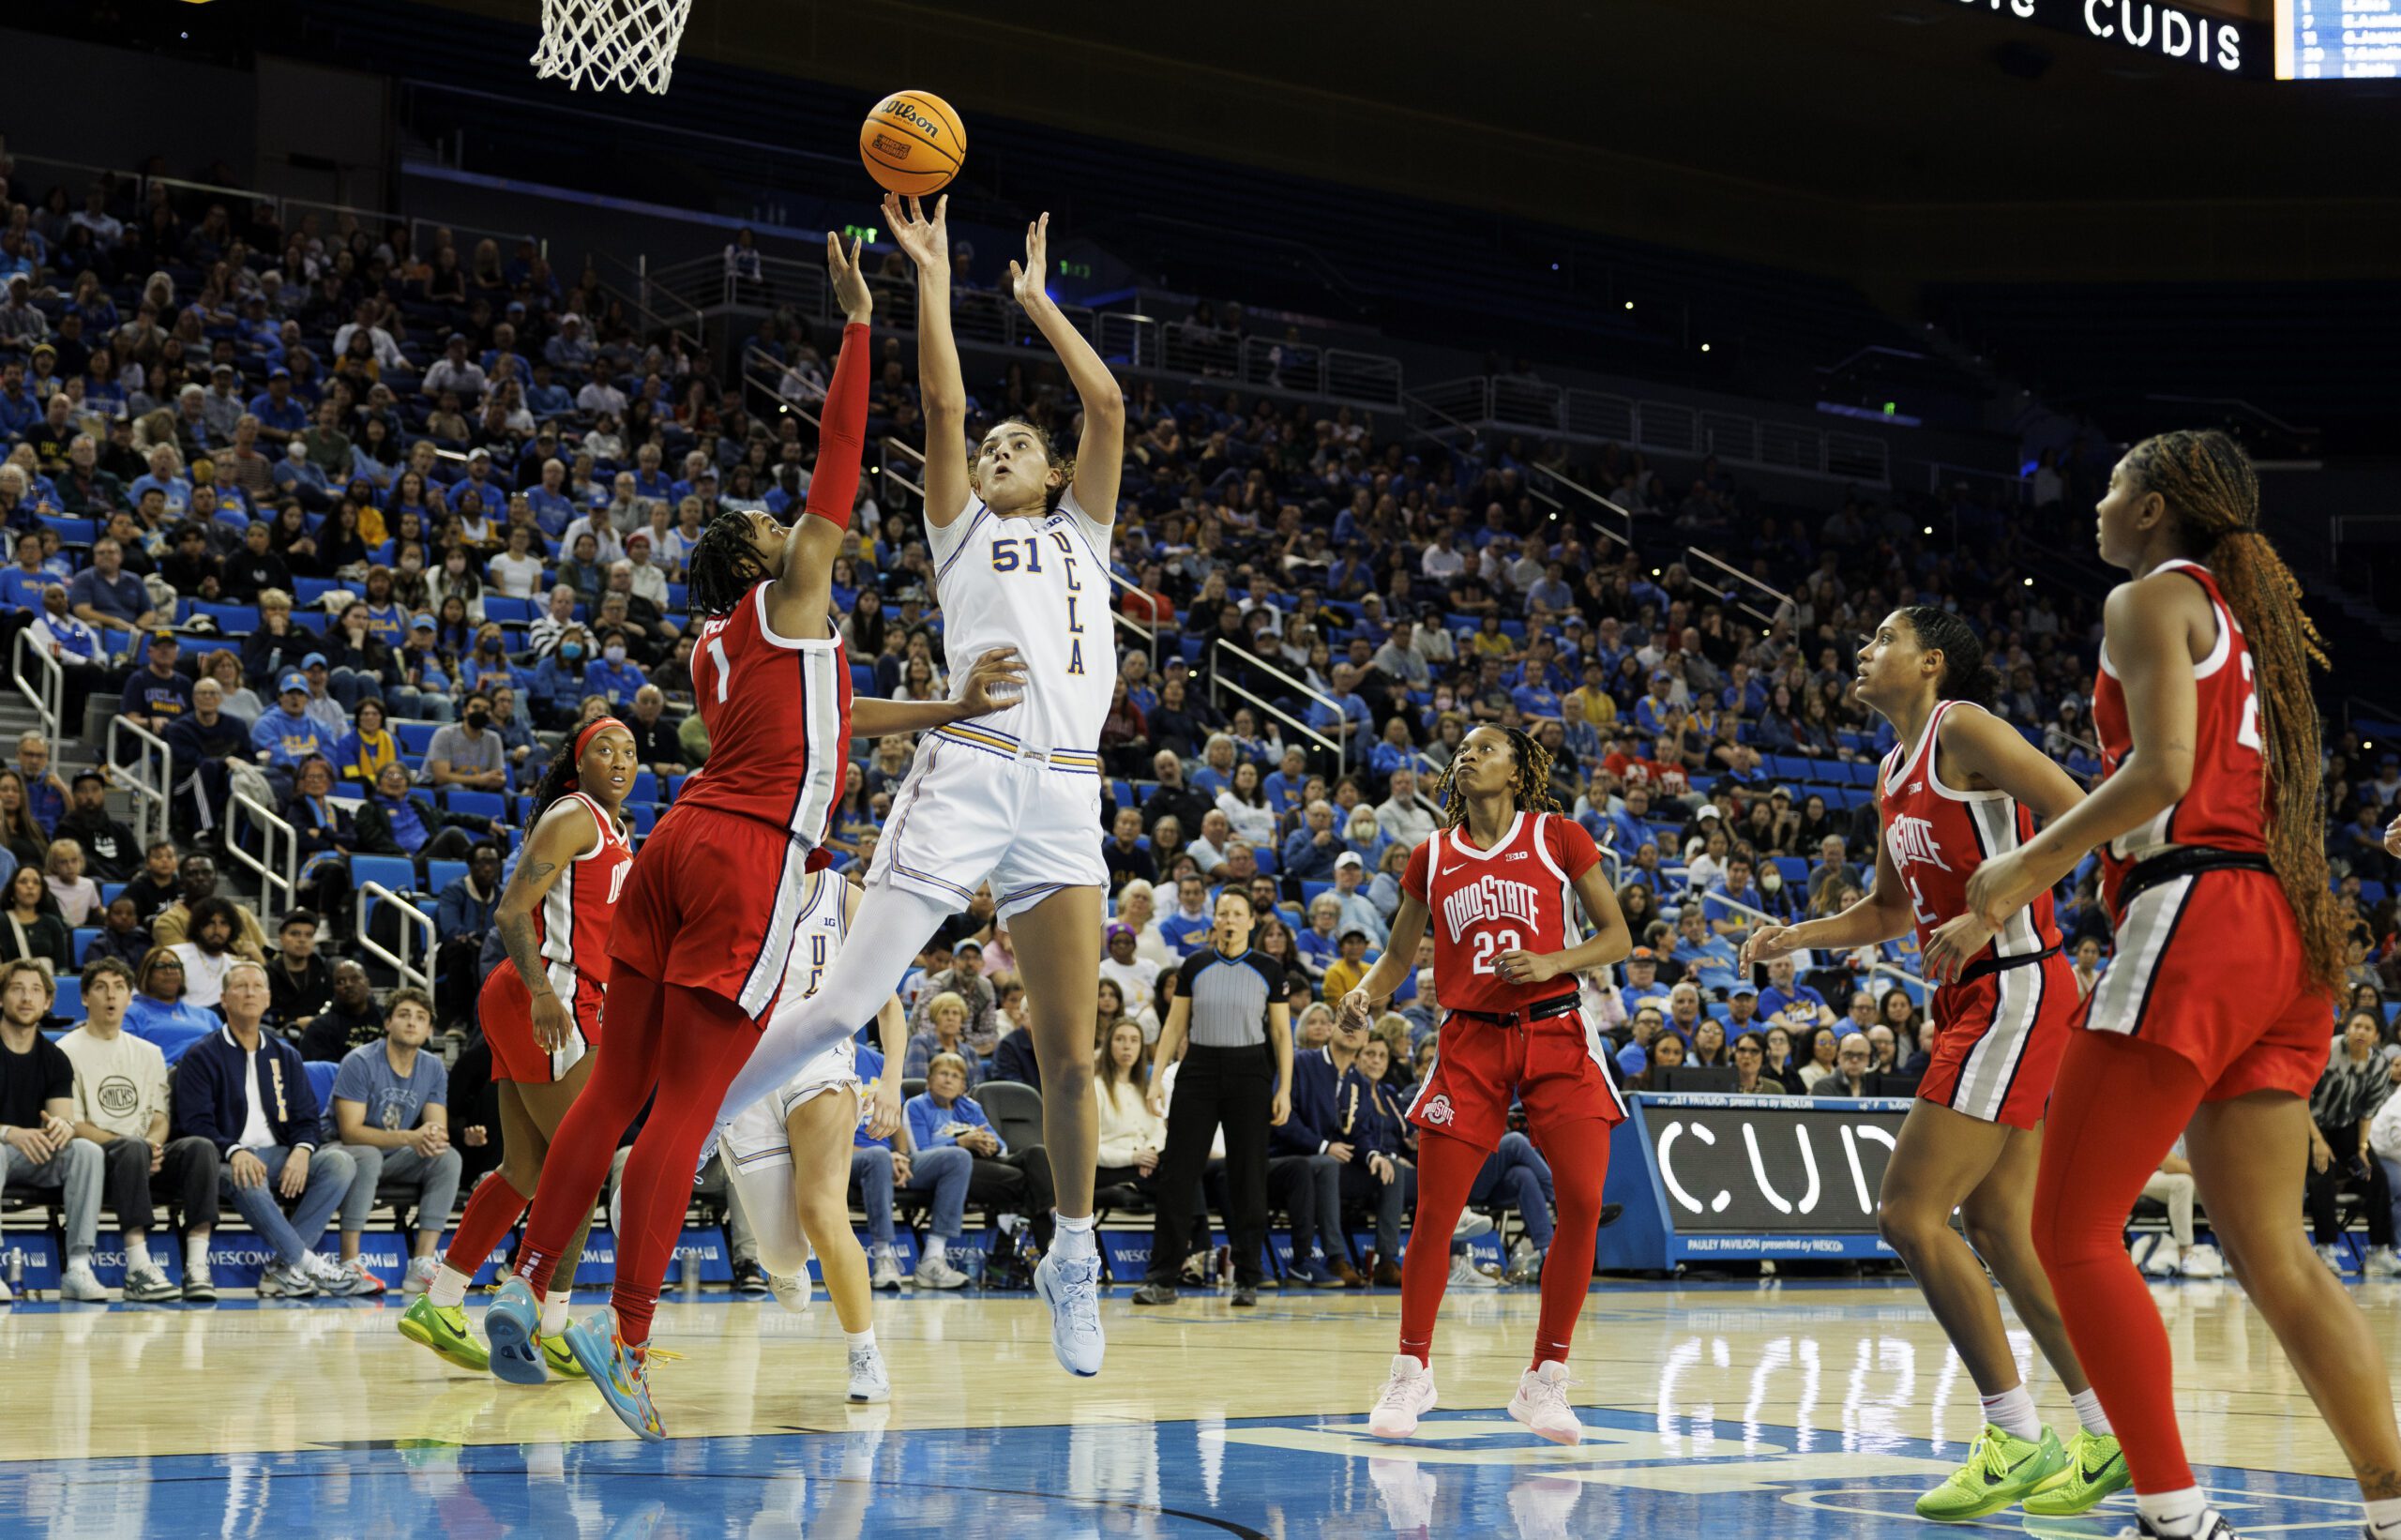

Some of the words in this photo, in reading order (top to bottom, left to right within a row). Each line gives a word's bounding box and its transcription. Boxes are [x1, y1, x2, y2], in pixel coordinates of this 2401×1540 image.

[2084, 0, 2240, 70] CUDIS
[882, 100, 940, 140] Wilson
[992, 537, 1042, 573] 51
[1049, 531, 1085, 675] UCLA
[706, 637, 730, 704] 1
[143, 687, 186, 708] UCLA
[1443, 883, 1484, 944] OHIO
[1481, 874, 1539, 936] STATE
[101, 1088, 133, 1107] KNICKS
[1657, 1122, 1896, 1215] CUD
[206, 1251, 270, 1265] WESCOM
[1720, 1239, 1759, 1250] PAVILION
